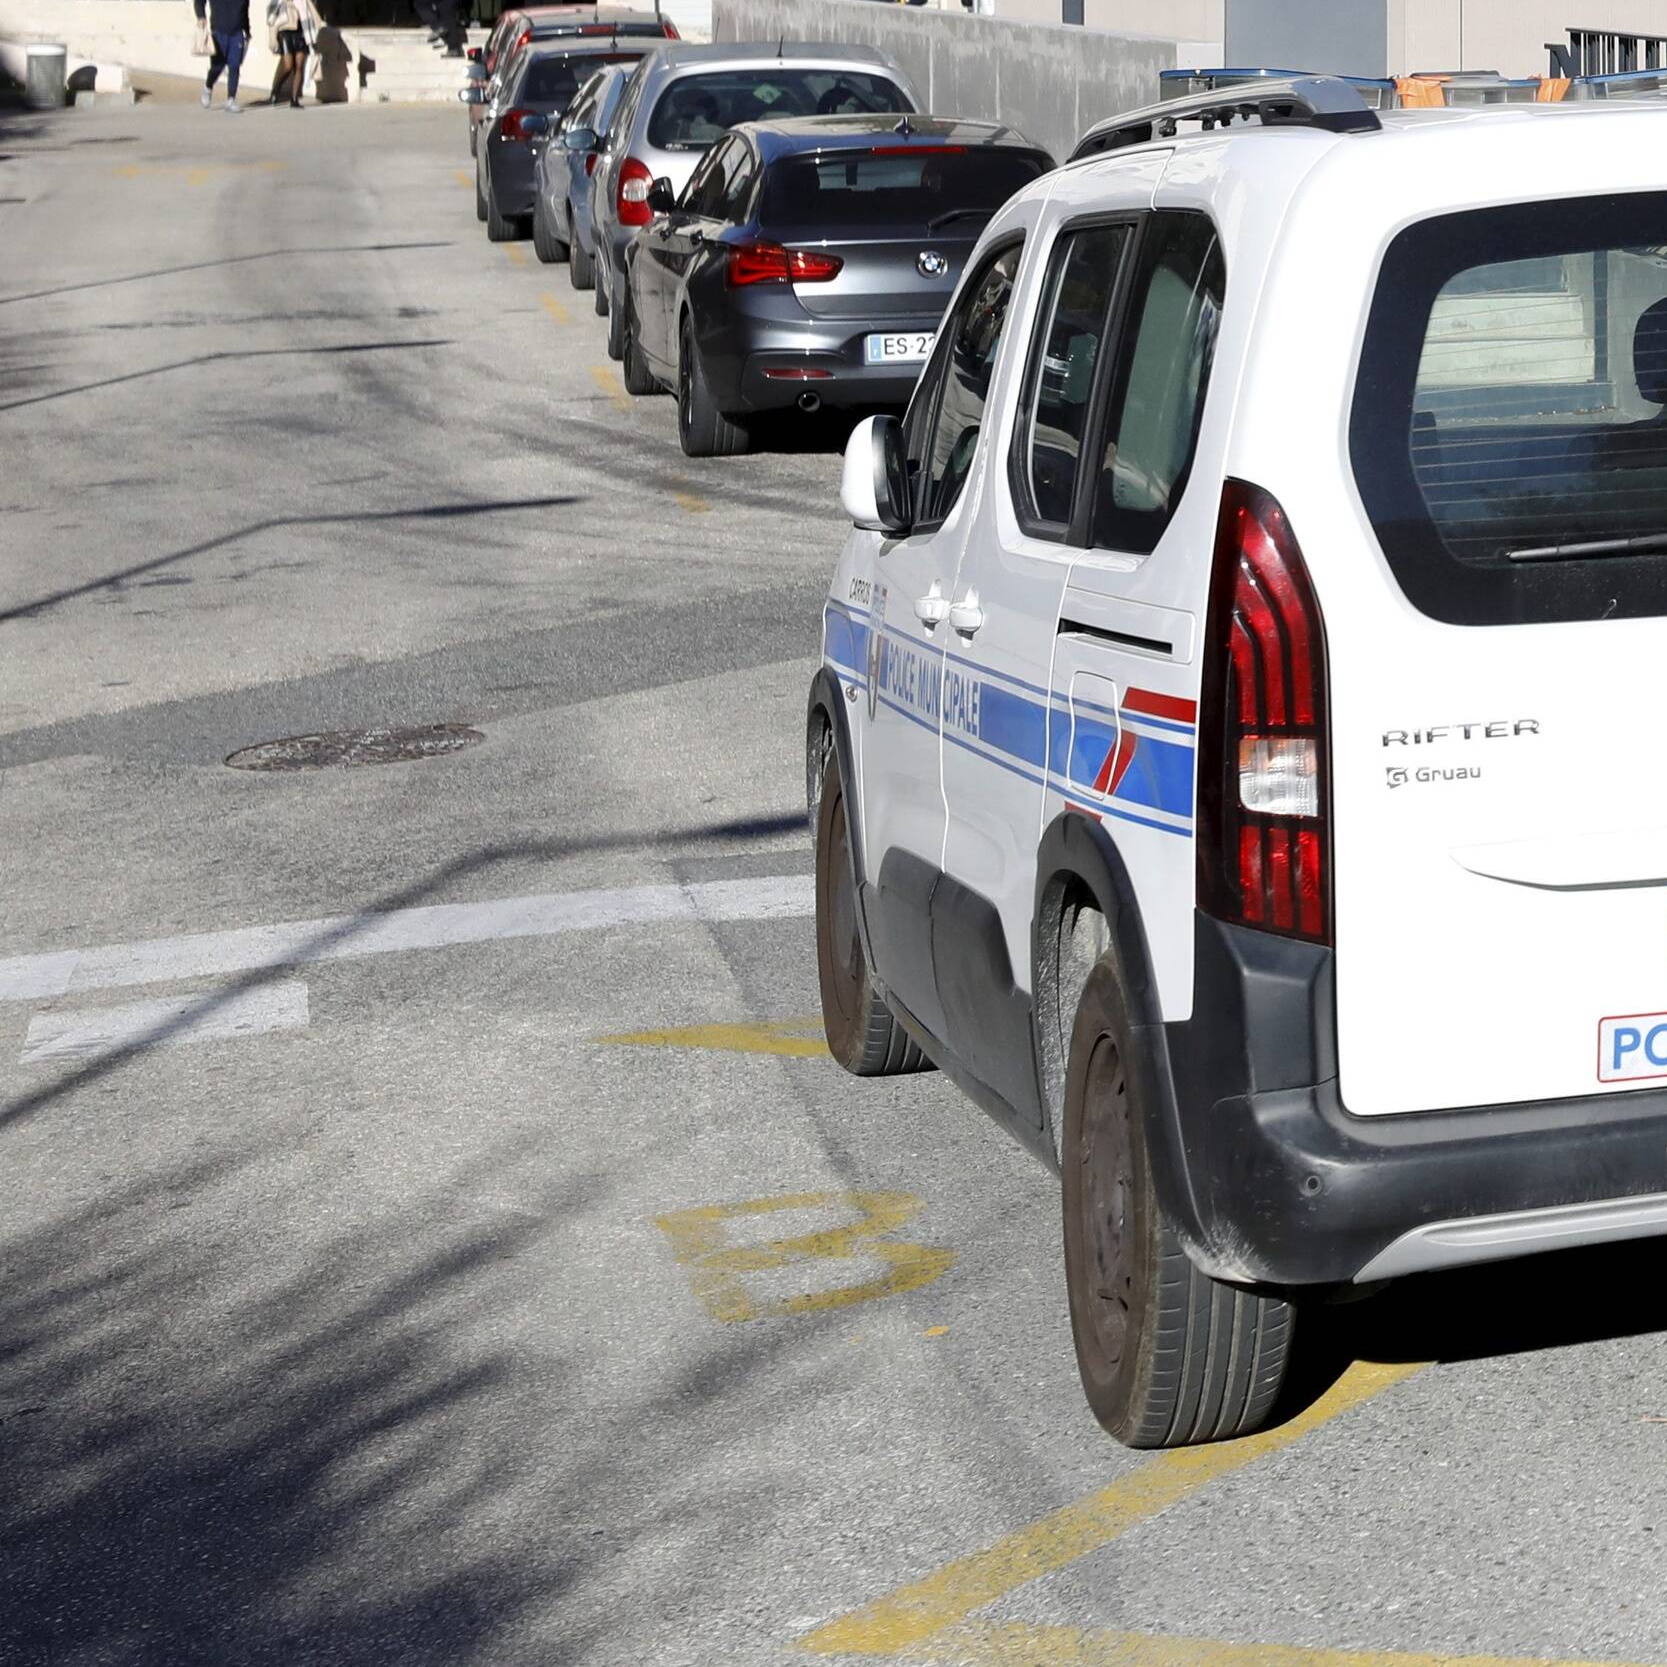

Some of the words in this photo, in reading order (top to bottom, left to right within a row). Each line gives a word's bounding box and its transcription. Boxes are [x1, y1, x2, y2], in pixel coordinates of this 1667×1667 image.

[848, 577, 872, 605] CARROS
[889, 642, 916, 705] POLICE
[917, 657, 979, 738] MUNICIPALE
[1382, 719, 1540, 748] RIFTER
[1415, 767, 1481, 782] Gruau
